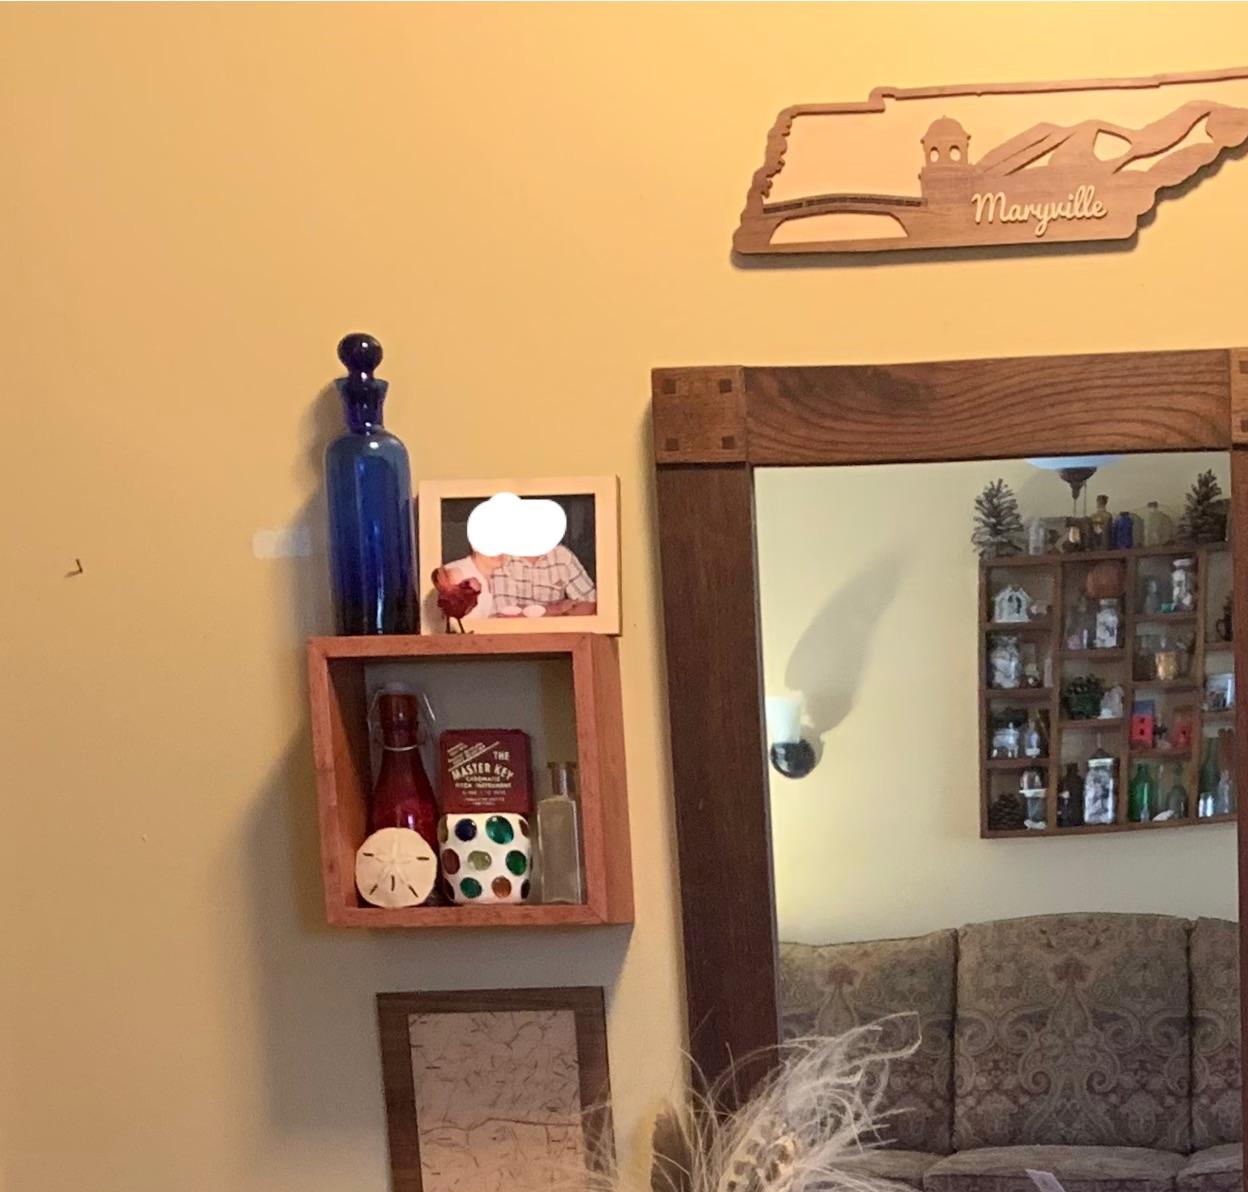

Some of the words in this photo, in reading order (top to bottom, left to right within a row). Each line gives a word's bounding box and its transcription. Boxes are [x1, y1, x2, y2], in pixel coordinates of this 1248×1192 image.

[971, 185, 1107, 236] Maryville
[493, 751, 510, 761] THE
[451, 763, 491, 780] MASTER
[493, 763, 515, 780] KEY
